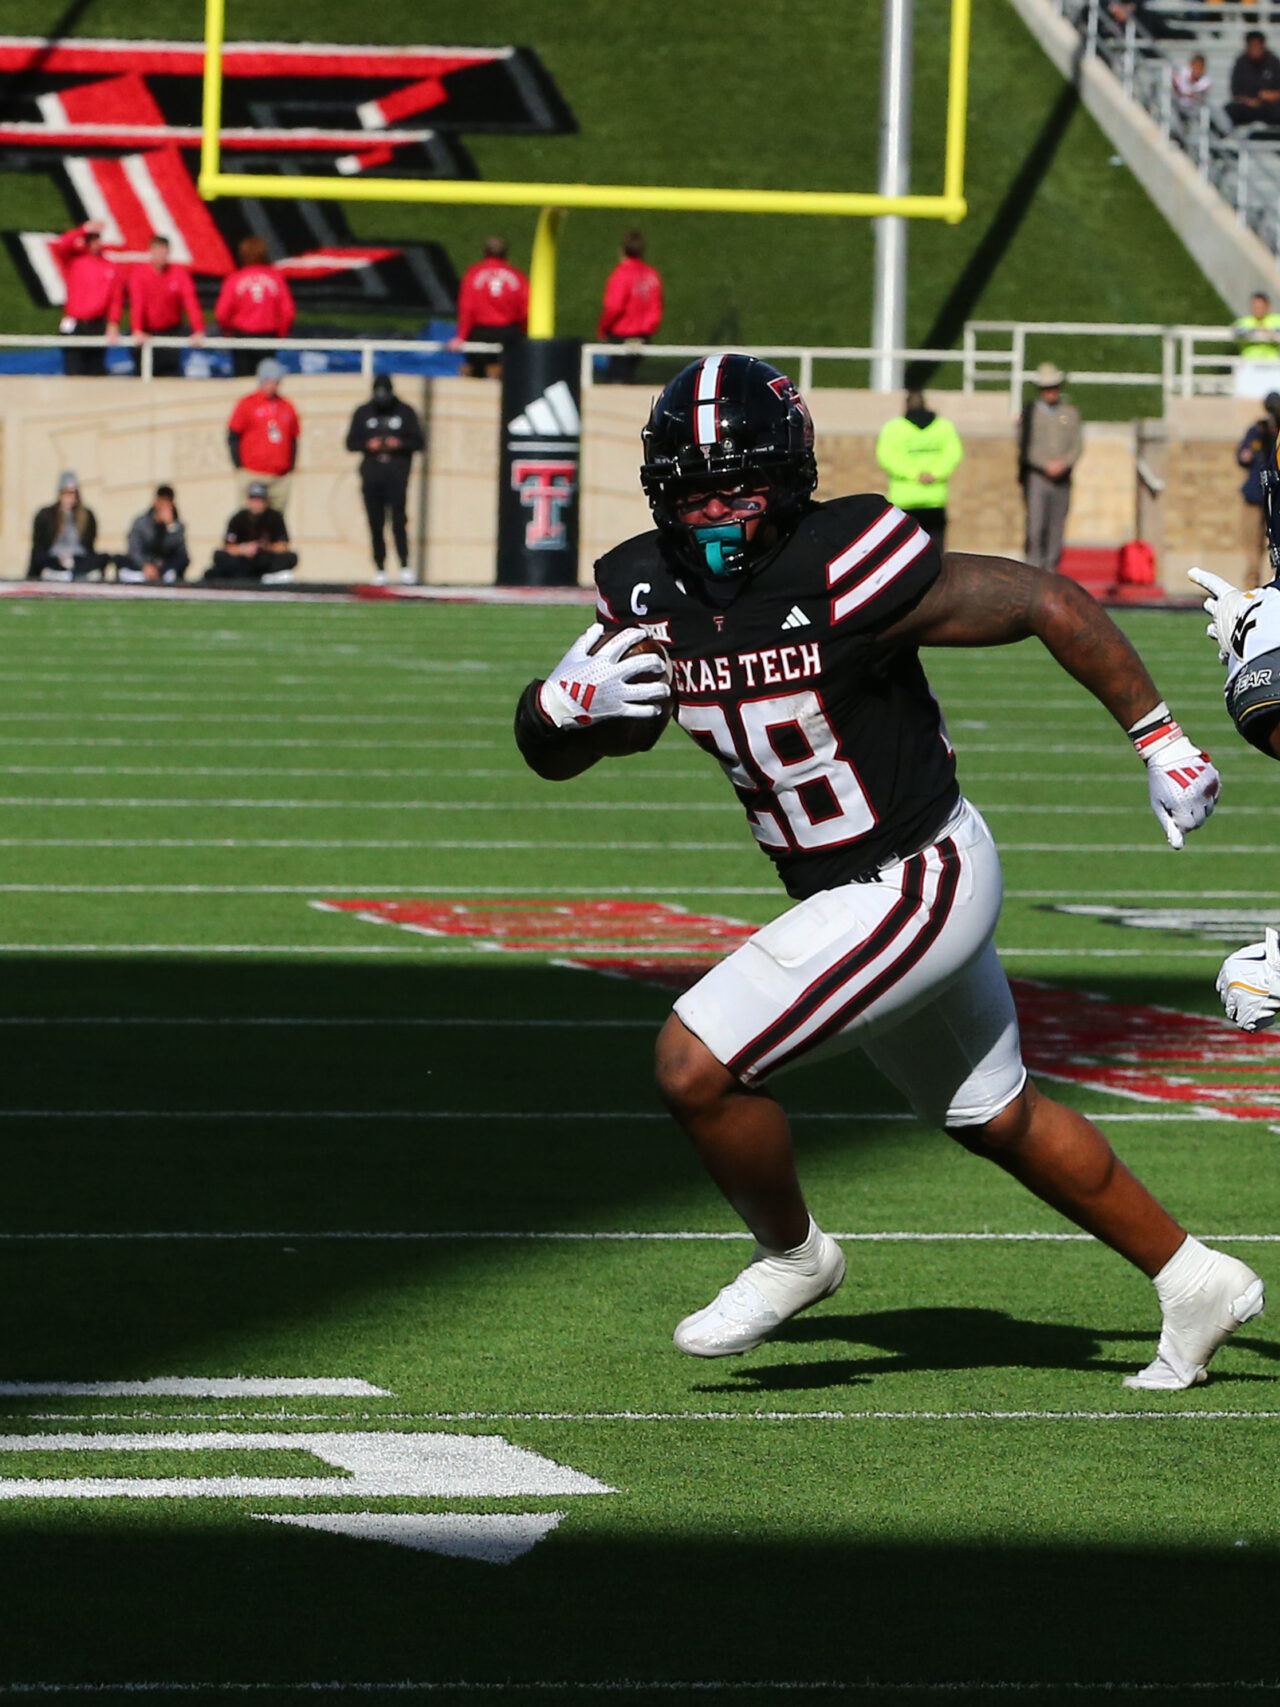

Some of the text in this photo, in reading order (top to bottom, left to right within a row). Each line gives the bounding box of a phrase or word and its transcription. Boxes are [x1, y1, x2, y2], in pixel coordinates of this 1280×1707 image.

[630, 582, 652, 617] C
[673, 642, 823, 694] EXAS TECH
[678, 688, 880, 852] 28
